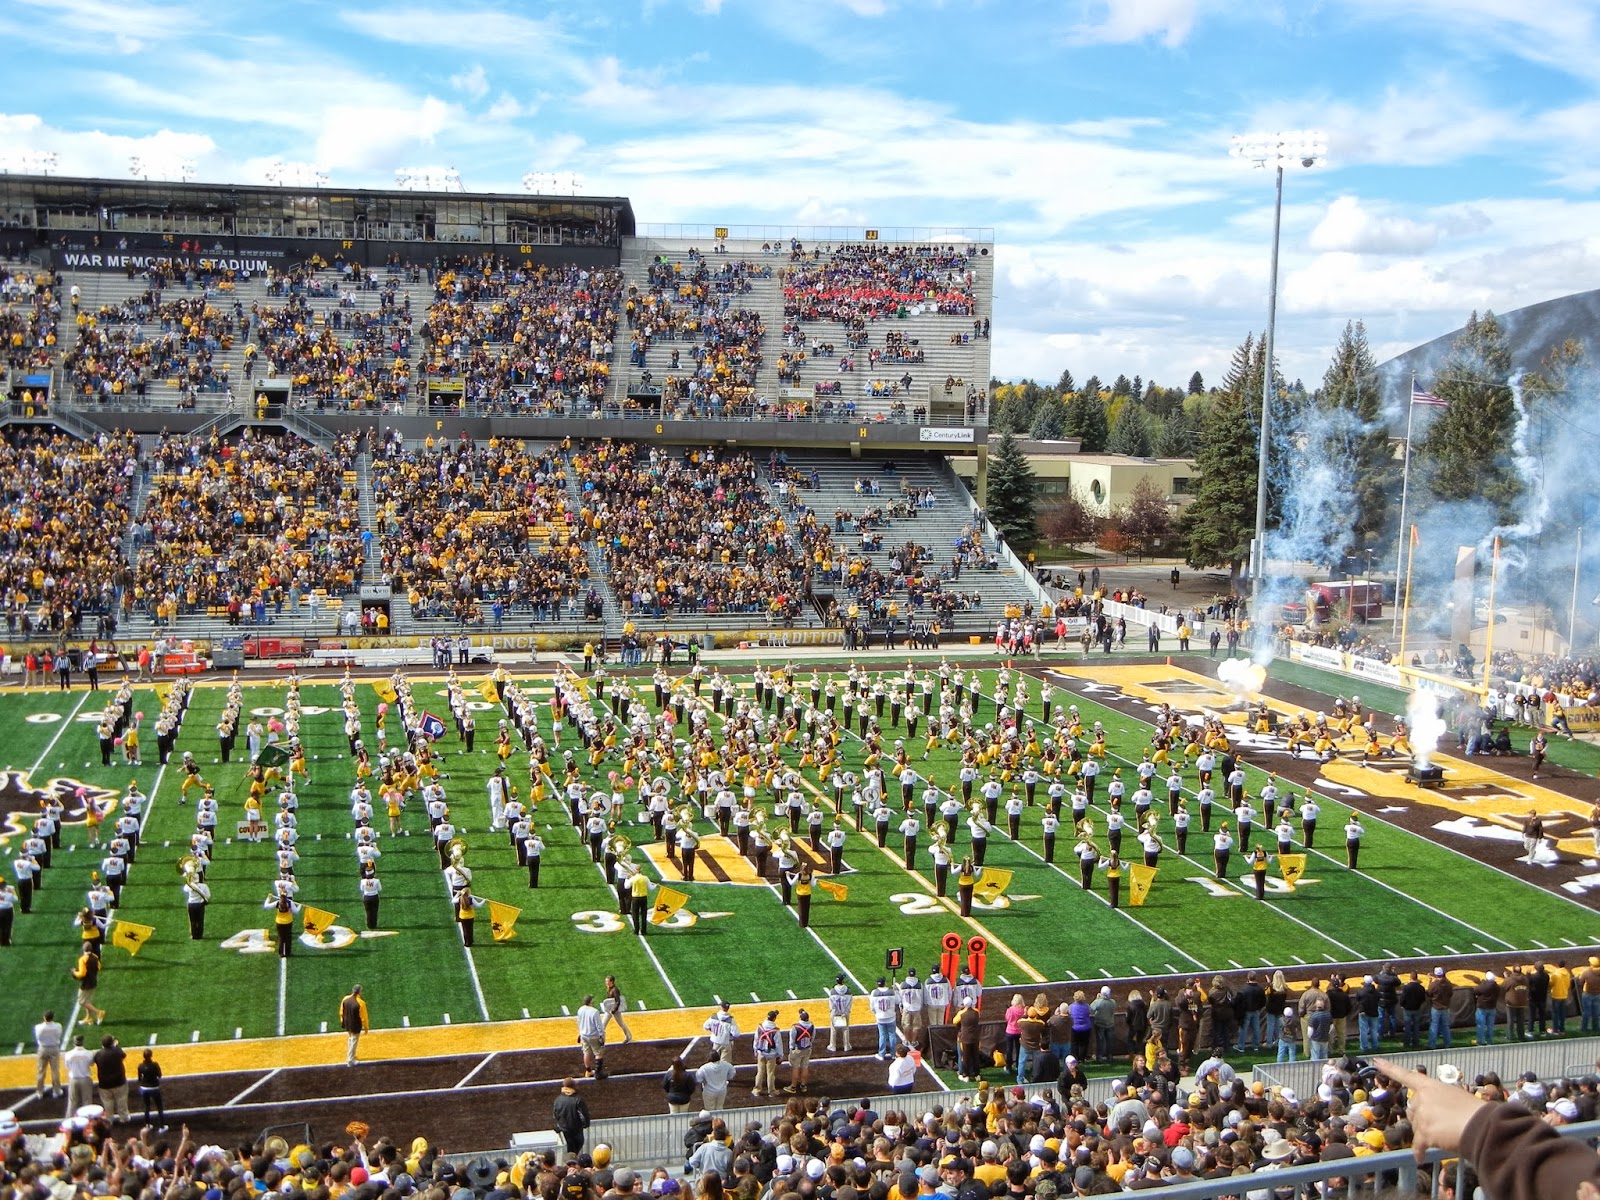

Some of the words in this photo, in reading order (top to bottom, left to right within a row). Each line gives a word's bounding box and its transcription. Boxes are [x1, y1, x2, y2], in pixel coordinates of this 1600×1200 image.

[342, 241, 353, 249] FF
[520, 245, 532, 253] GG
[65, 254, 101, 266] WAR
[199, 258, 268, 271] STADIUM
[436, 420, 443, 431] F
[656, 424, 663, 434] G
[860, 427, 867, 438] H
[756, 631, 847, 645] TRADITION
[891, 951, 898, 966] 1
